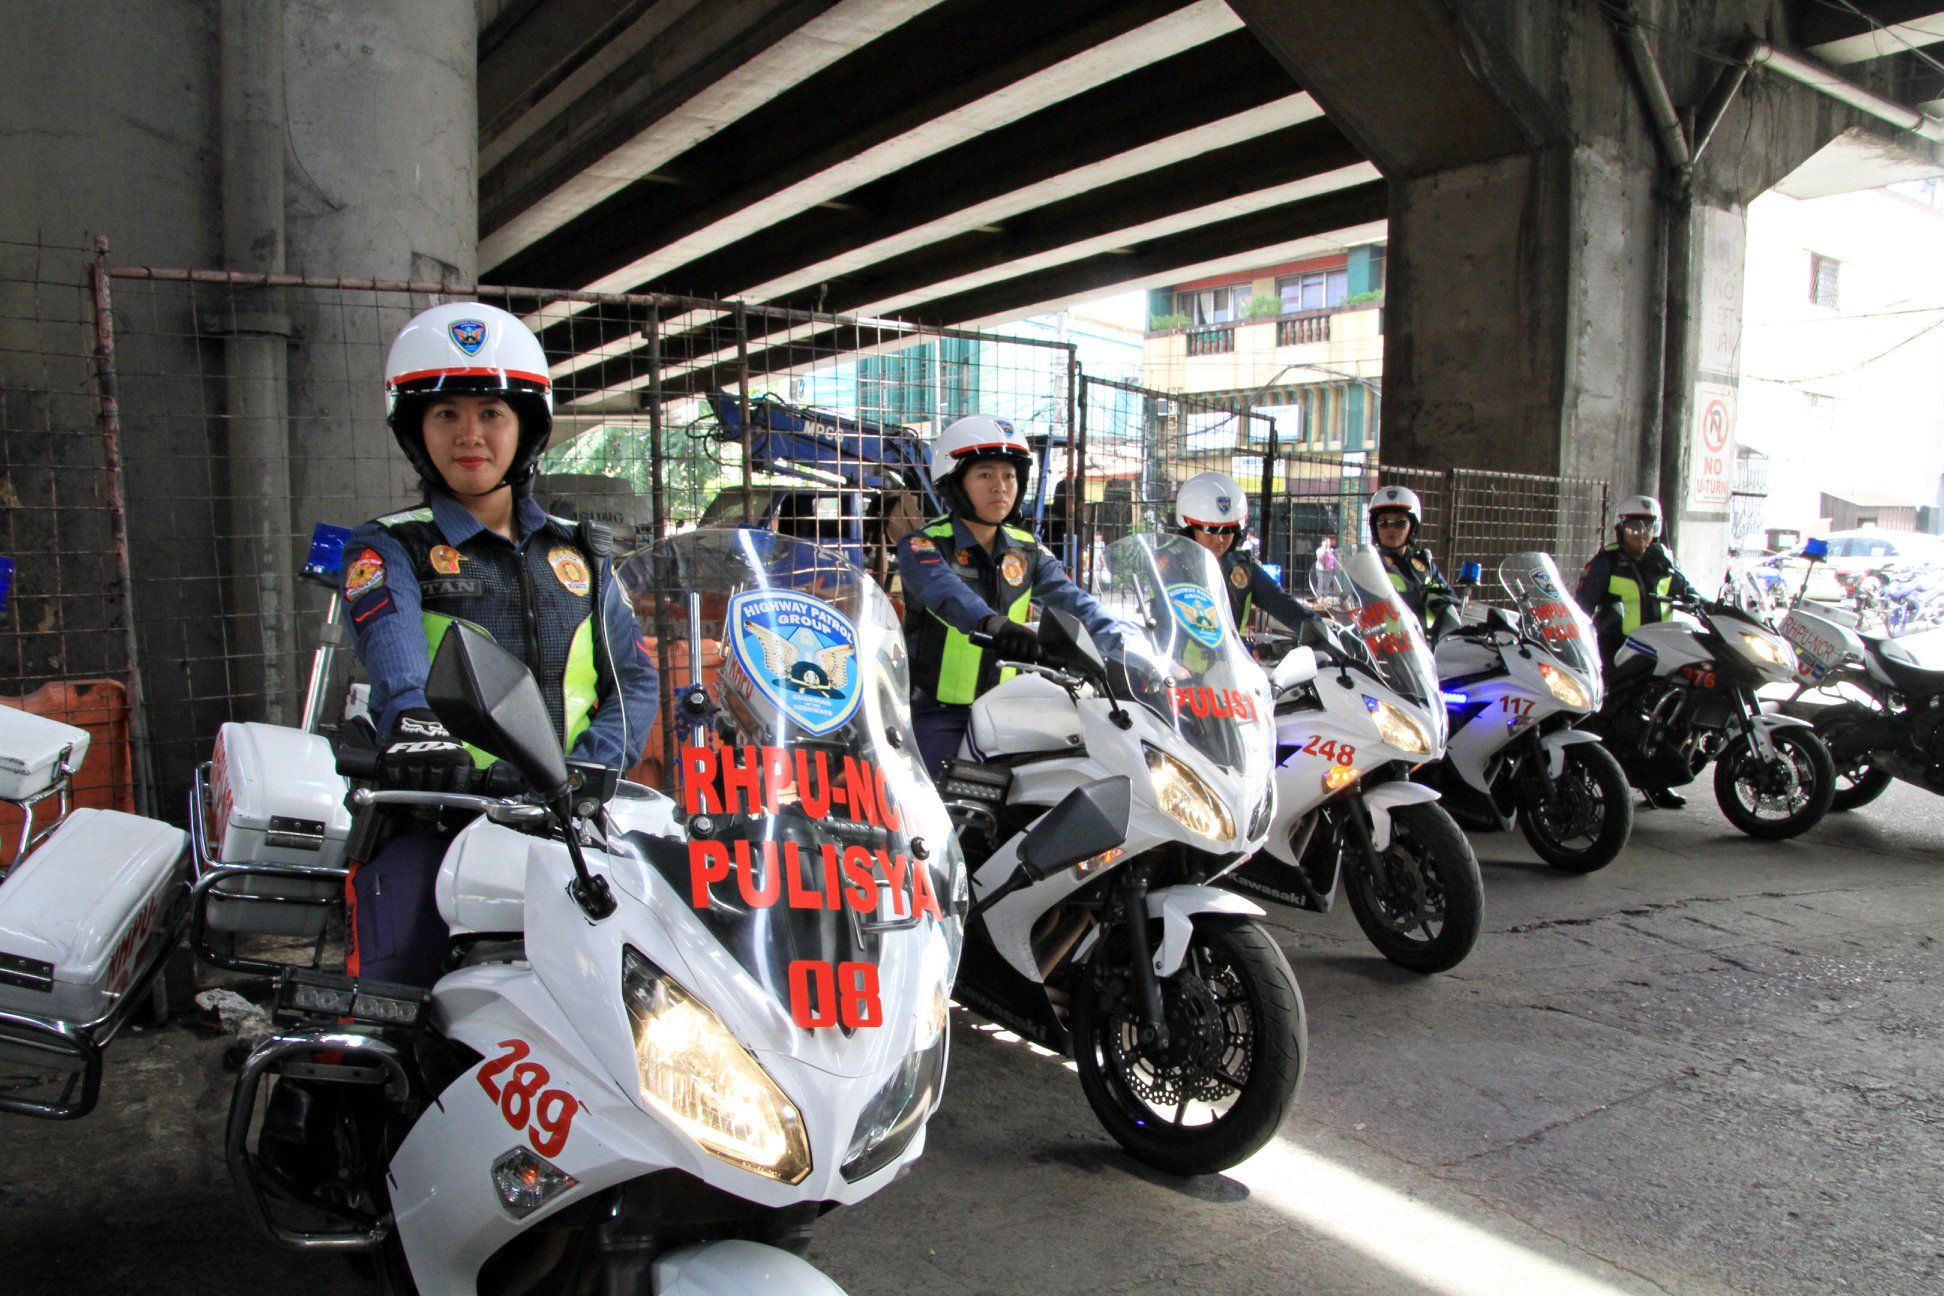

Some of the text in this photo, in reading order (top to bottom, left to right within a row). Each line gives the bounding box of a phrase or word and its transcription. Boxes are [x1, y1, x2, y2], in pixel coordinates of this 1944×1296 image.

[1704, 457, 1722, 475] NO
[1697, 479, 1727, 494] U-TURN
[743, 600, 853, 643] HIGHWAY PATROL
[778, 614, 832, 634] GROUP
[1500, 696, 1536, 716] 117
[386, 741, 462, 753] FOX
[1302, 735, 1356, 767] 248
[681, 744, 910, 836] RHPU-NC
[688, 839, 944, 922] PULISYA
[1227, 872, 1307, 906] Kawasaki
[788, 960, 883, 1028] 08
[476, 1038, 579, 1158] 289
